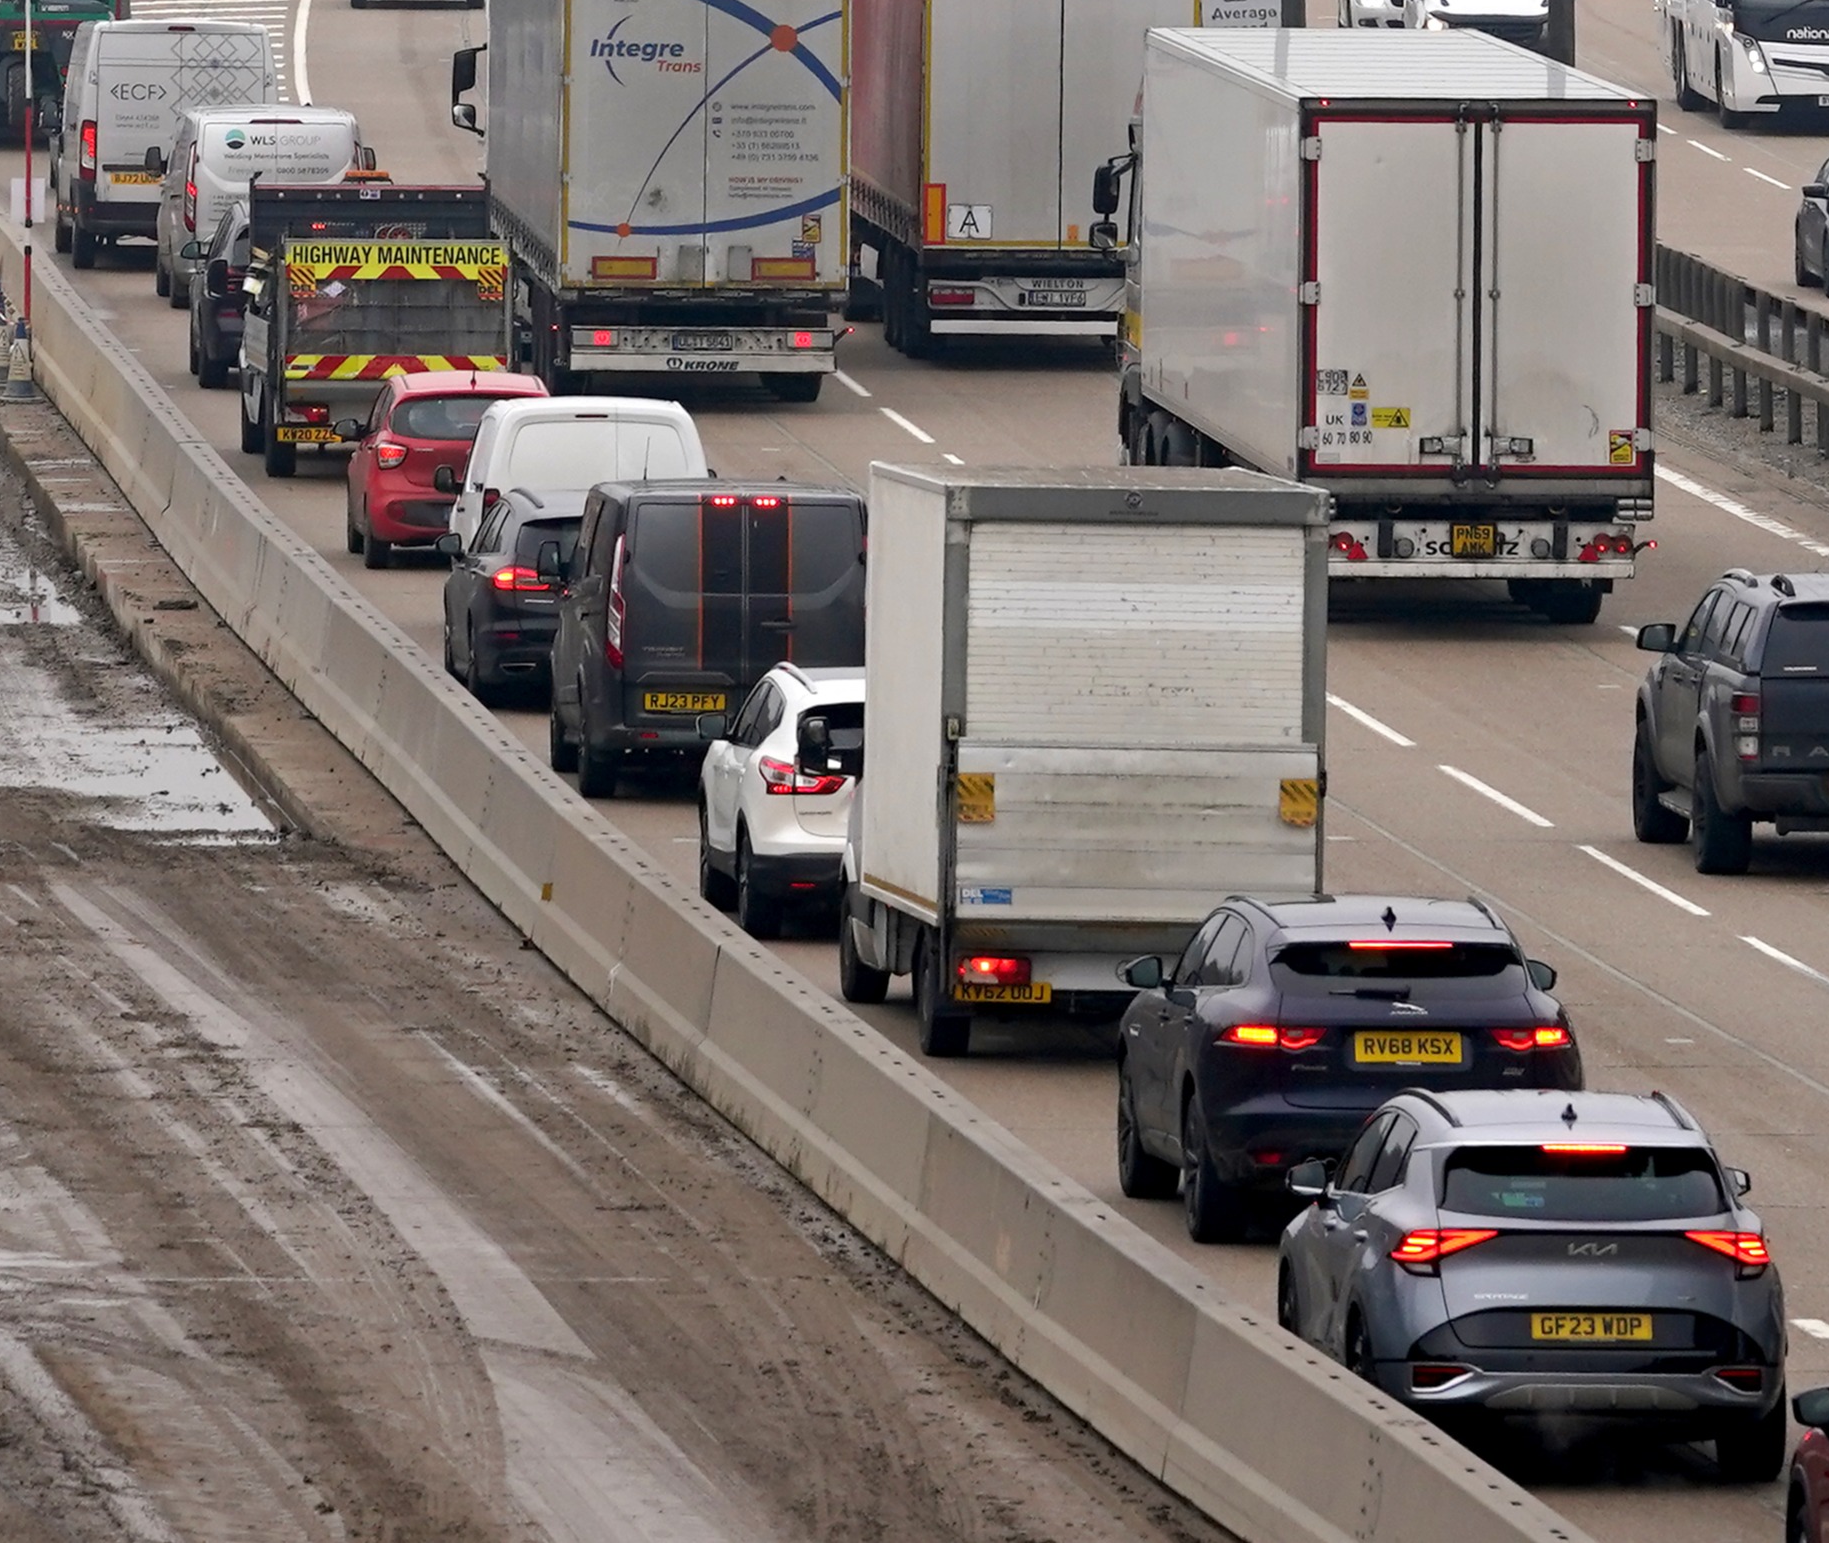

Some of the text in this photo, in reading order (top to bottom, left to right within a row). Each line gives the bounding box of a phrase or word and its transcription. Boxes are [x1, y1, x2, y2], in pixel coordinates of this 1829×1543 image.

[1211, 7, 1278, 21] Average
[590, 39, 685, 62] Integre
[657, 59, 702, 74] Trans
[249, 135, 321, 146] WLS GROUP
[959, 210, 980, 233] A
[292, 245, 501, 265] HIGHWAY MAINTENANCE
[684, 360, 739, 371] KRONE
[1326, 415, 1344, 425] UK
[1322, 430, 1373, 445] 60 70 80 90
[1456, 527, 1491, 540] PN69
[649, 694, 721, 709] RJ23 PFY
[1363, 1037, 1455, 1056] RV68 KSX
[1541, 1317, 1643, 1336] GF23 WDP
